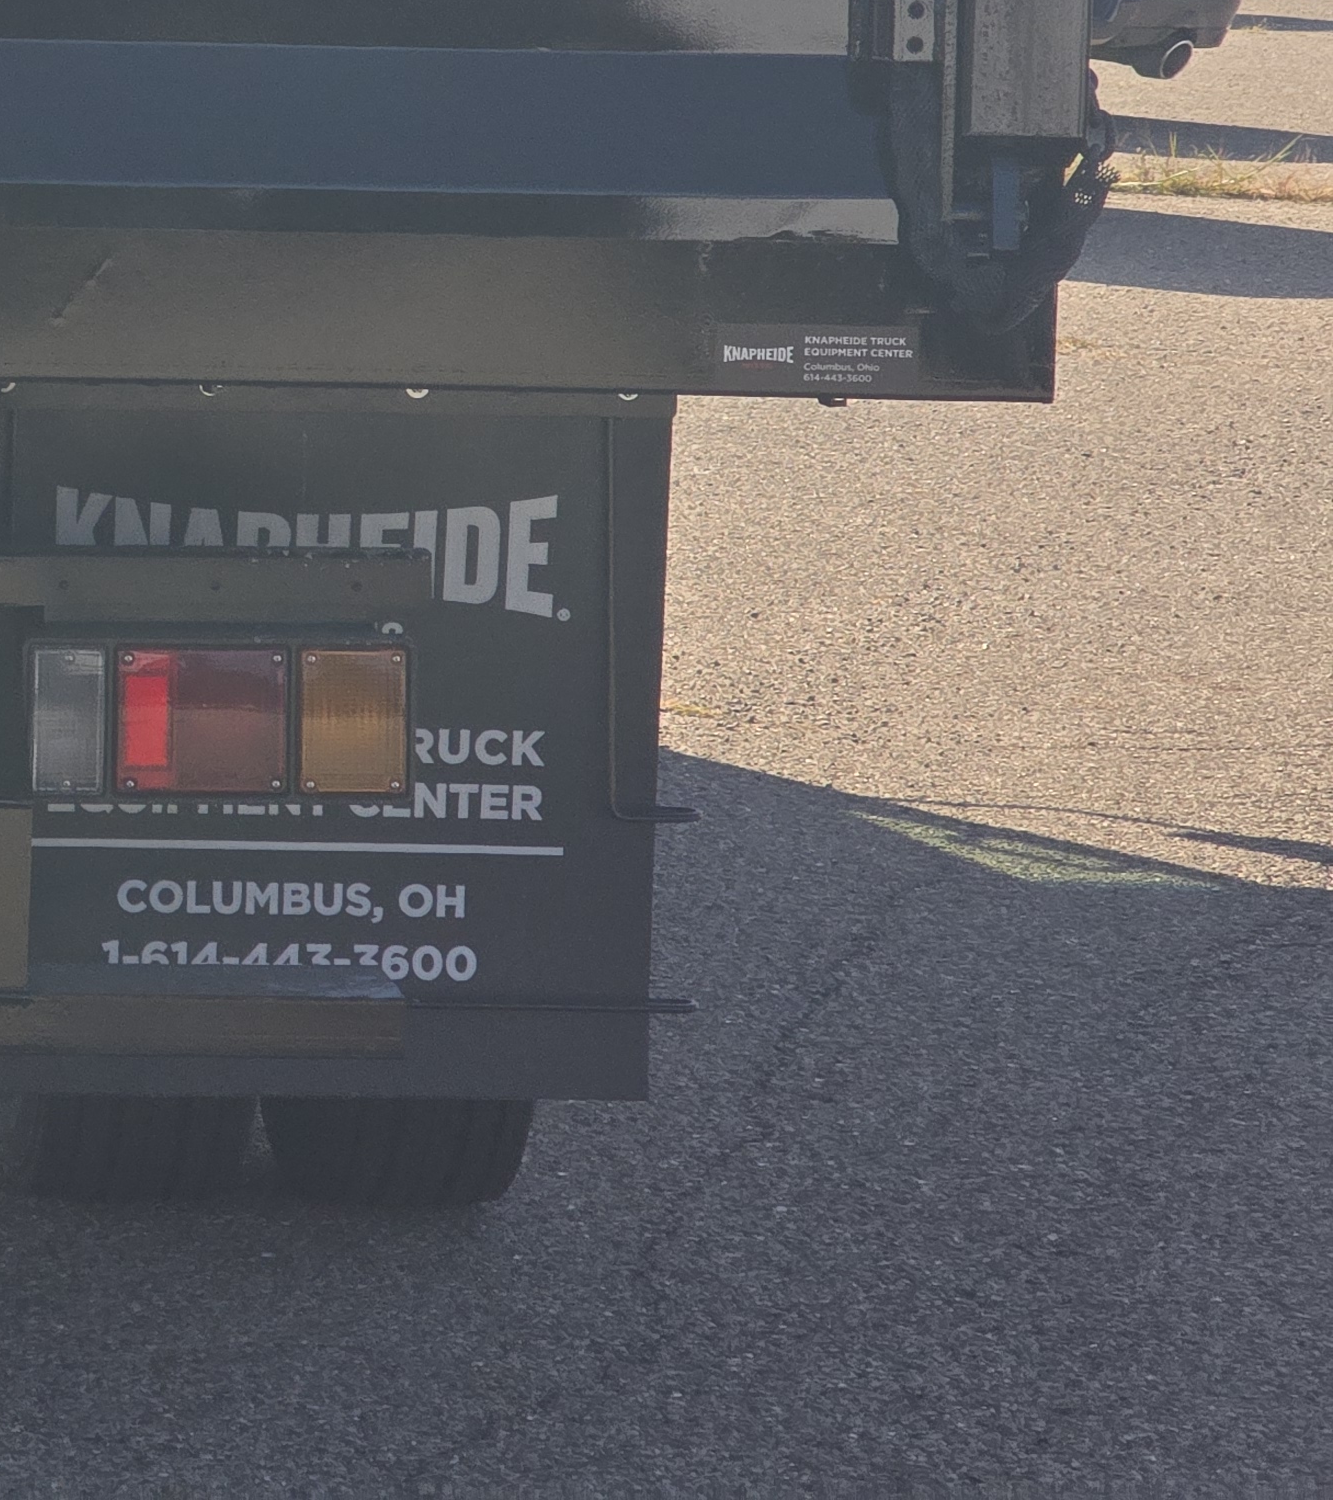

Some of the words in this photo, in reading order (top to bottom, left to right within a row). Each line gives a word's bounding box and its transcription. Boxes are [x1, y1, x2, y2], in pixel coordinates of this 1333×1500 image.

[804, 335, 867, 346] KNAPHEIDE
[870, 336, 906, 346] TRUCK
[723, 345, 794, 364] KNAPHEIDE
[804, 347, 867, 357] EQUIPMENT
[870, 348, 913, 358] CENTER
[803, 362, 855, 373] Columbus,
[857, 363, 880, 372] Ohio
[803, 373, 872, 383] 614-443-3600
[117, 879, 383, 922] COLUMBUS,
[398, 884, 466, 918] OH
[102, 940, 477, 982] 1-614-443-3600
